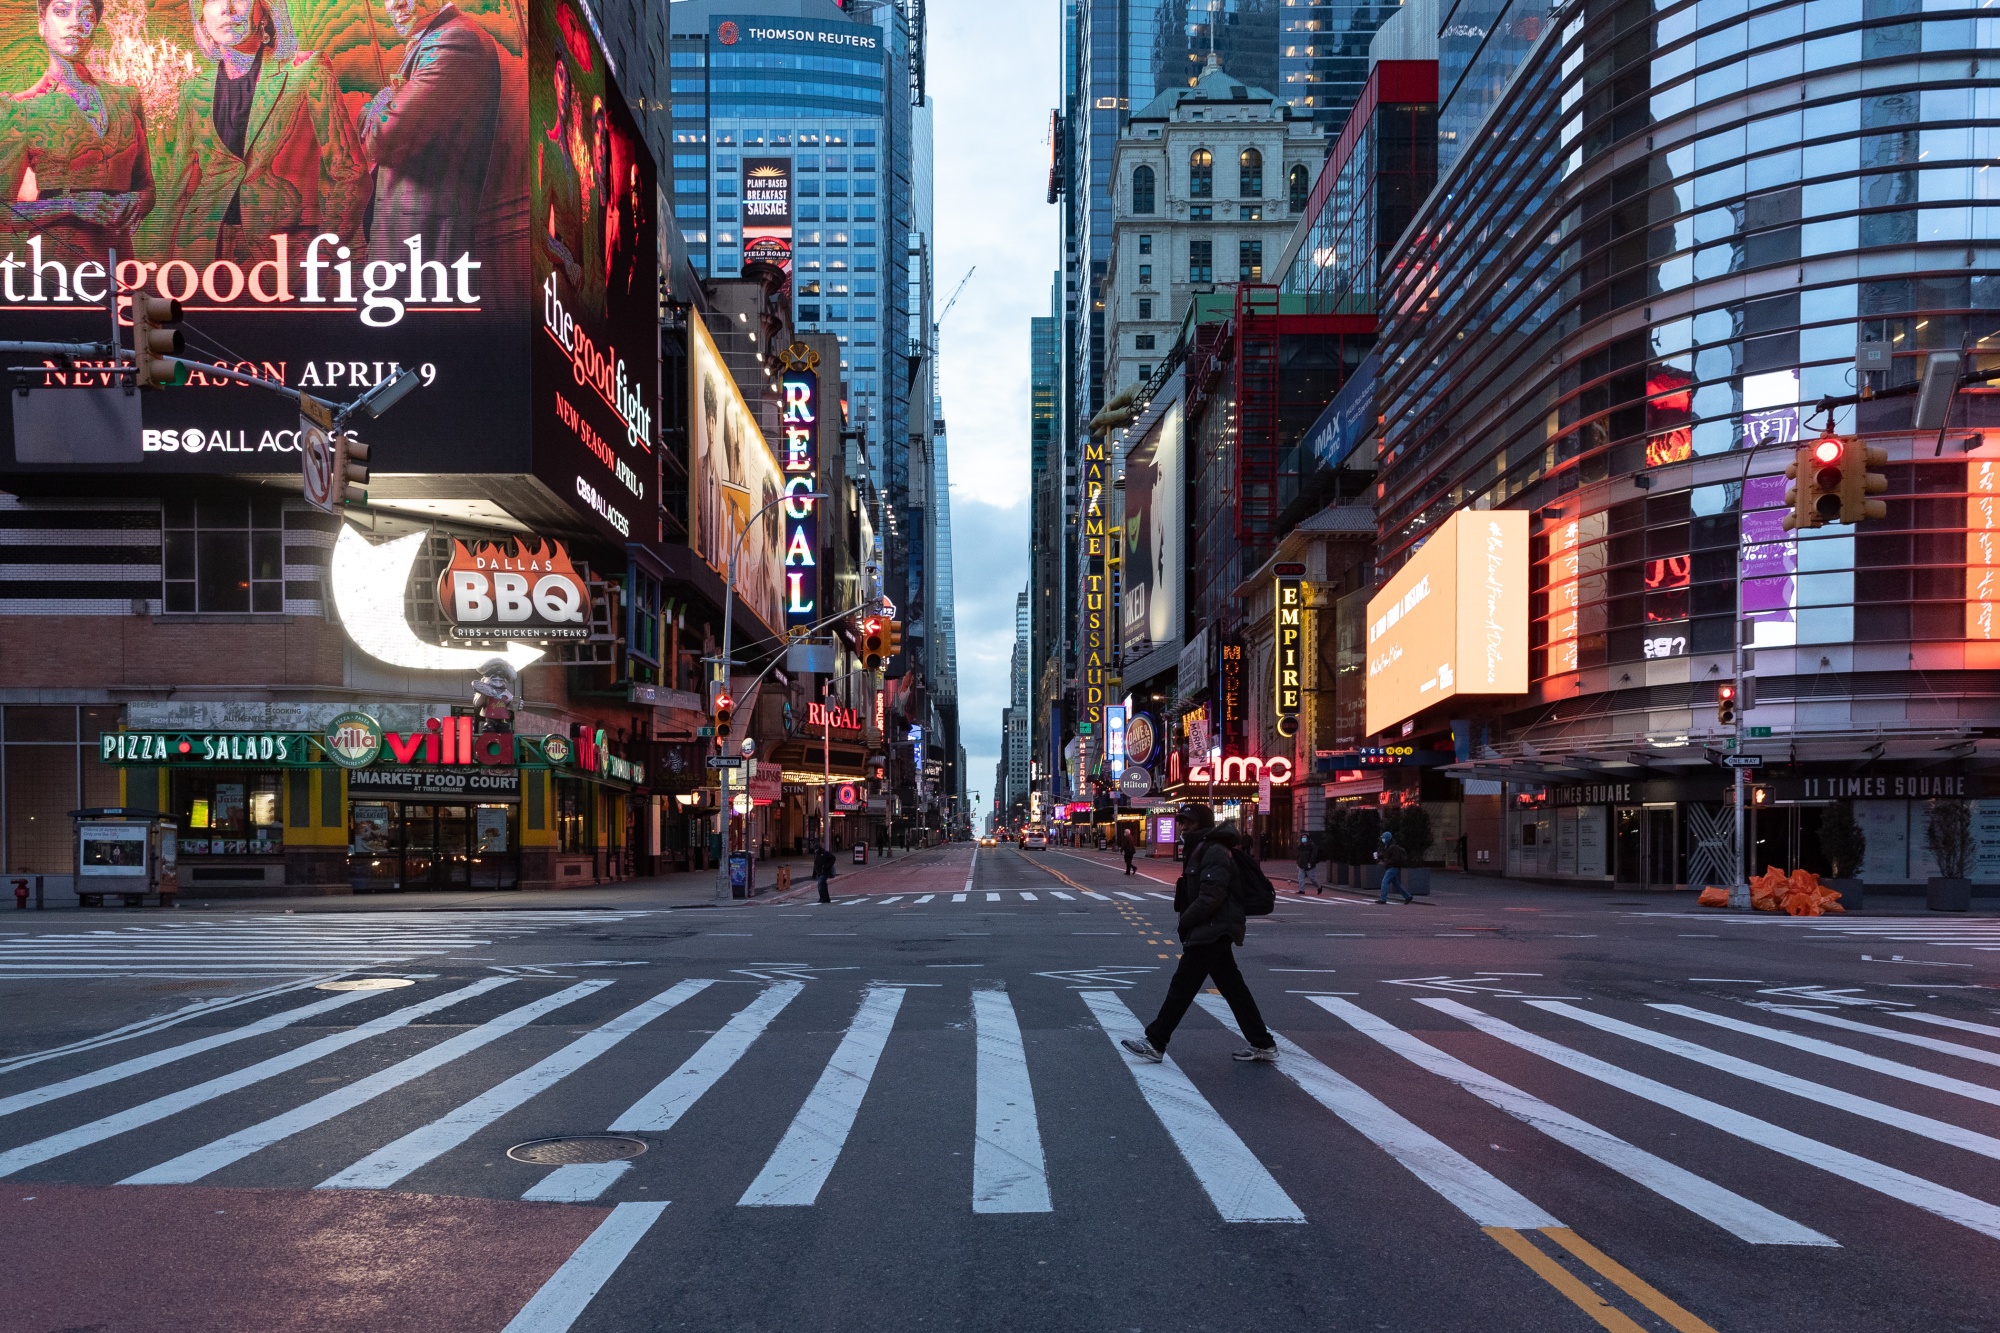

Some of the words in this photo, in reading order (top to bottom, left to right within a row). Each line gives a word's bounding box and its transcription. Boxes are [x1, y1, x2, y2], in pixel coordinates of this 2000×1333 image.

[749, 28, 814, 42] THOMSON
[818, 32, 876, 49] REUTERS
[747, 179, 788, 188] PLANT-BASED
[747, 190, 787, 200] BREAKFAST
[747, 202, 788, 215] SAUSAGE
[0, 235, 107, 302] the
[111, 233, 295, 326] good
[300, 233, 482, 327] fight
[543, 271, 574, 352] the
[573, 323, 616, 404] good
[615, 358, 652, 448] fight
[43, 361, 130, 386] NEW
[185, 361, 287, 386] ASON
[420, 363, 436, 387] 9
[142, 429, 181, 452] BS
[207, 430, 254, 452] ALL
[1314, 410, 1340, 459] IMAX
[555, 391, 580, 435] NEW
[580, 419, 615, 472] SEASON
[615, 457, 638, 496] APRIL
[638, 482, 644, 500] 9
[576, 475, 591, 503] CBS
[596, 494, 607, 518] ALL
[607, 504, 629, 537] ACCESS
[783, 382, 816, 613] REGAL
[1085, 444, 1104, 555] MADAME
[476, 557, 553, 571] DALLAS
[453, 570, 584, 623] BBQ
[458, 628, 481, 637] RIBS
[493, 629, 540, 637] CHICKEN
[551, 629, 587, 637] STEAKS
[1086, 575, 1102, 723] TUSSAUD'S
[1280, 588, 1300, 707] EMPIRE
[1223, 645, 1241, 757] MODELL'S
[327, 730, 377, 749] villa
[385, 716, 515, 765] villa
[1128, 726, 1145, 743] DAVE
[1144, 724, 1150, 736] &
[1190, 722, 1207, 763] MORMON
[1755, 728, 1760, 736] 8
[104, 735, 167, 759] PIZZA
[203, 736, 288, 760] SALADS
[544, 743, 569, 756] villa
[1129, 739, 1151, 757] BUSTER'S
[356, 771, 423, 786] MARKET
[425, 774, 466, 788] FOOD
[469, 776, 518, 789] COURT
[654, 773, 701, 782] CRUMBS
[1188, 756, 1292, 783] amc
[782, 785, 804, 794] STIN
[839, 785, 856, 805] Q
[1123, 781, 1148, 789] Hilton
[1556, 786, 1582, 804] TIMES
[1585, 783, 1631, 803] SQUARE
[1804, 778, 1819, 797] 11
[1827, 777, 1886, 797] TIMES
[1894, 776, 1965, 797] SQUARE
[355, 811, 388, 819] BREAKFAST
